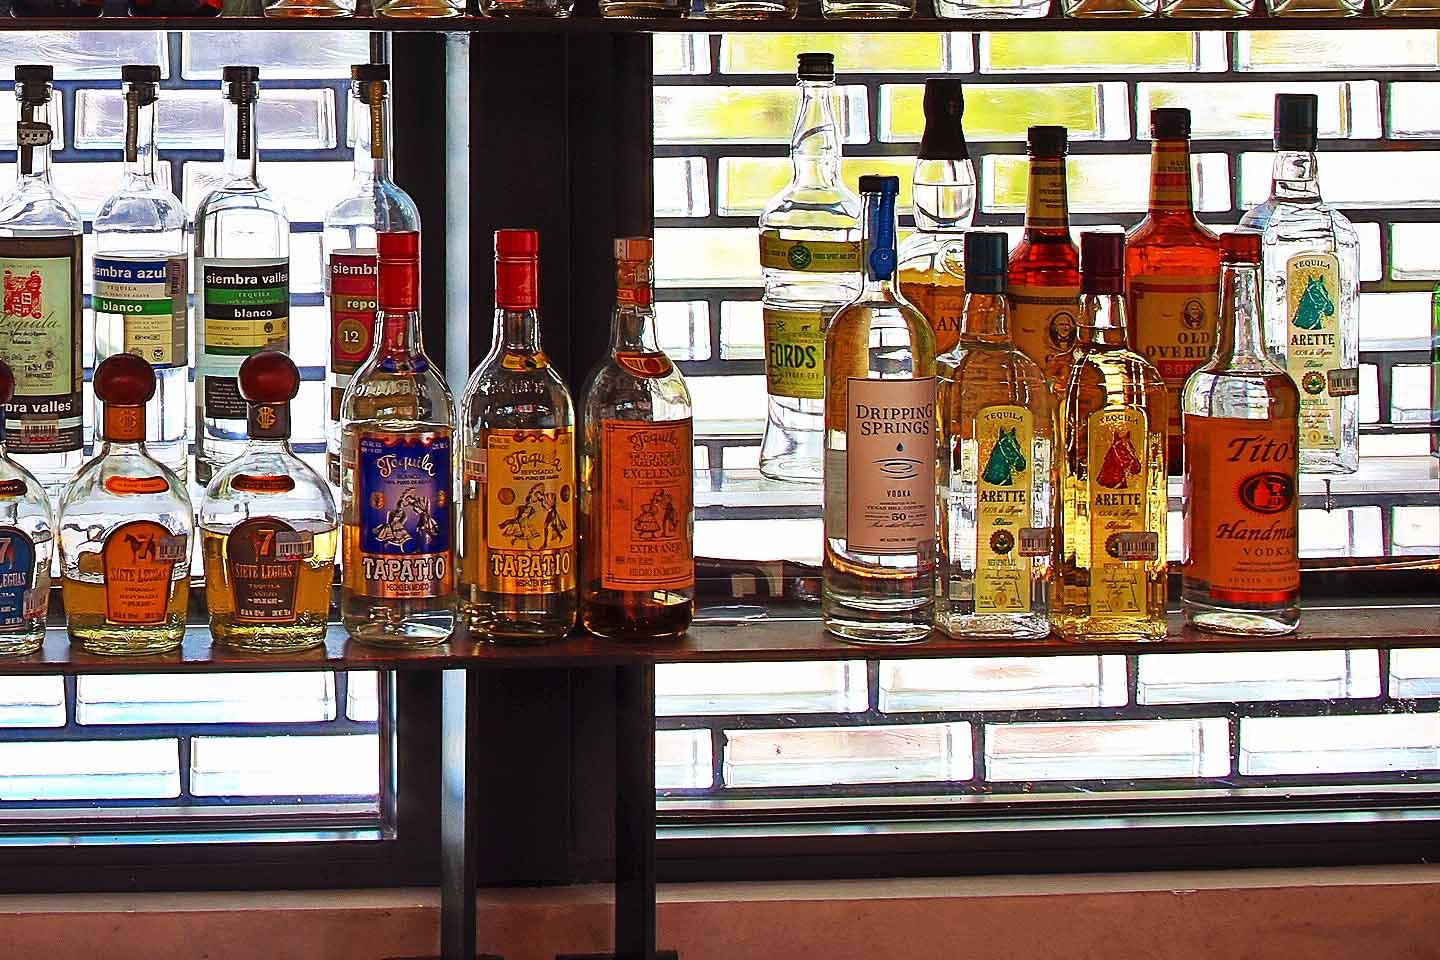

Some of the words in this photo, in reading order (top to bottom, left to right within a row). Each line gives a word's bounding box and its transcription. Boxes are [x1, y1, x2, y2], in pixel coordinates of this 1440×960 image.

[333, 262, 377, 275] siembr
[1294, 260, 1331, 269] TEQUILA
[95, 267, 133, 280] embra
[137, 267, 166, 280] azul
[207, 272, 258, 285] siembra
[102, 302, 142, 313] blanco
[234, 308, 272, 318] blanco
[343, 329, 358, 342] 12
[1178, 332, 1209, 344] OLD
[1291, 334, 1334, 345] ARETTE
[769, 343, 816, 370] FORDS
[32, 401, 71, 413] valles
[856, 404, 933, 421] DRIPPING
[984, 414, 1023, 422] TEQUILA
[861, 420, 929, 436] SPRINGS
[377, 454, 436, 477] Tequila
[888, 489, 910, 497] VODKA
[979, 490, 1026, 503] ARETTE
[1095, 494, 1140, 506] ARETTE
[892, 513, 906, 521] 50
[362, 557, 446, 580] TAPATIO
[491, 554, 570, 577] TAPATIO
